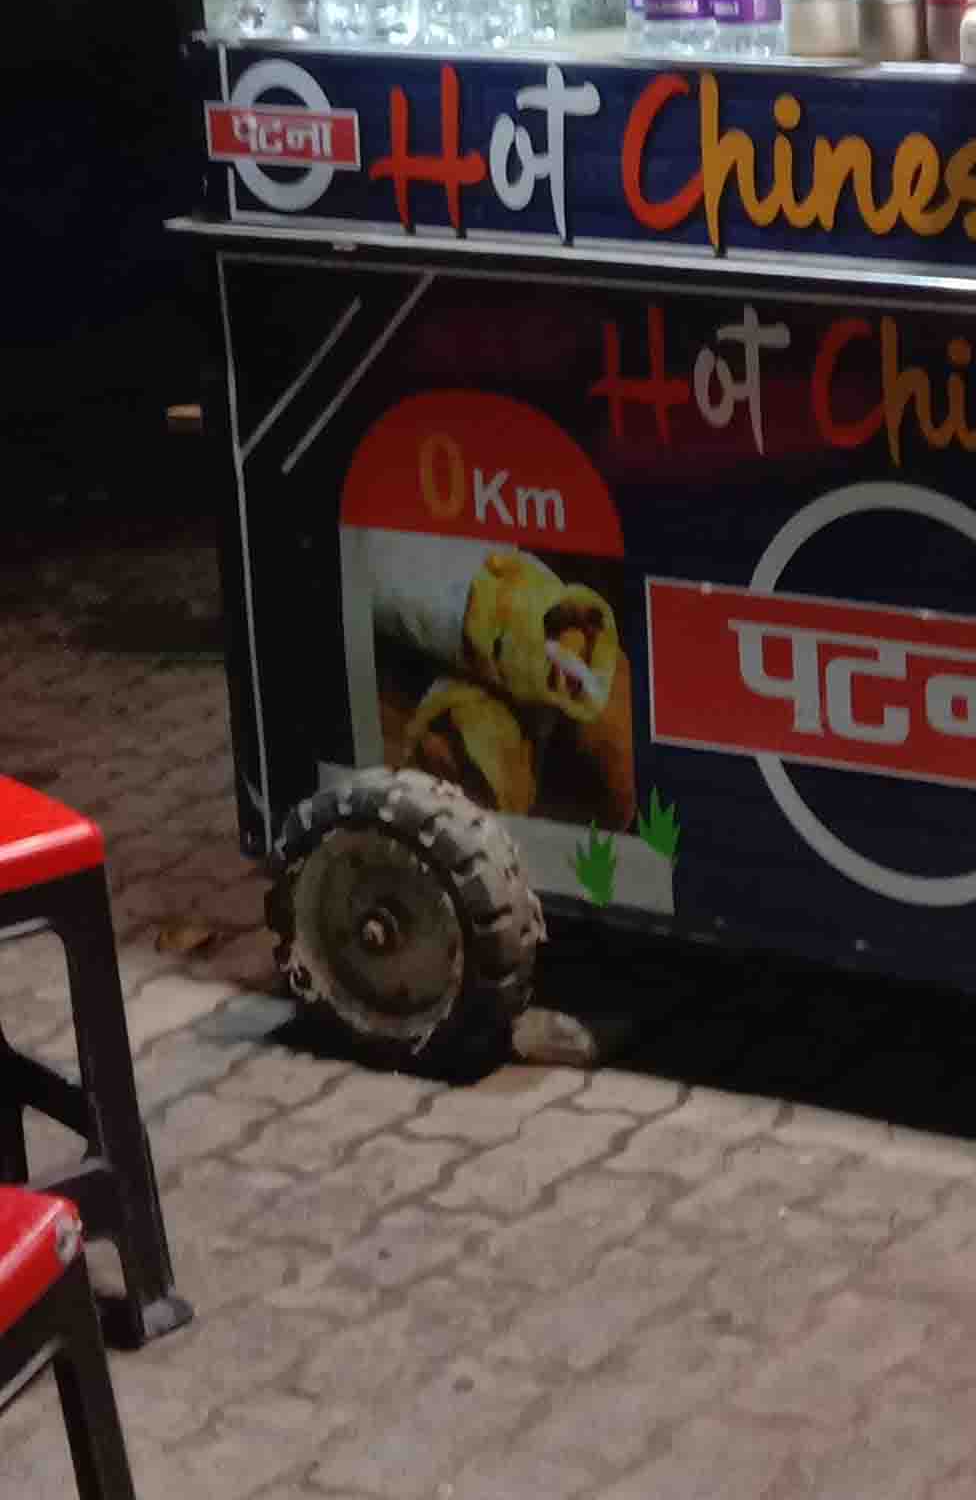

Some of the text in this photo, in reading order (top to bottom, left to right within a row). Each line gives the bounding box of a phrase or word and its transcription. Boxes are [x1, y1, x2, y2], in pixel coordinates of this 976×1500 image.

[231, 114, 335, 158] पटना
[370, 61, 601, 246] Hot
[589, 305, 790, 455] Hot
